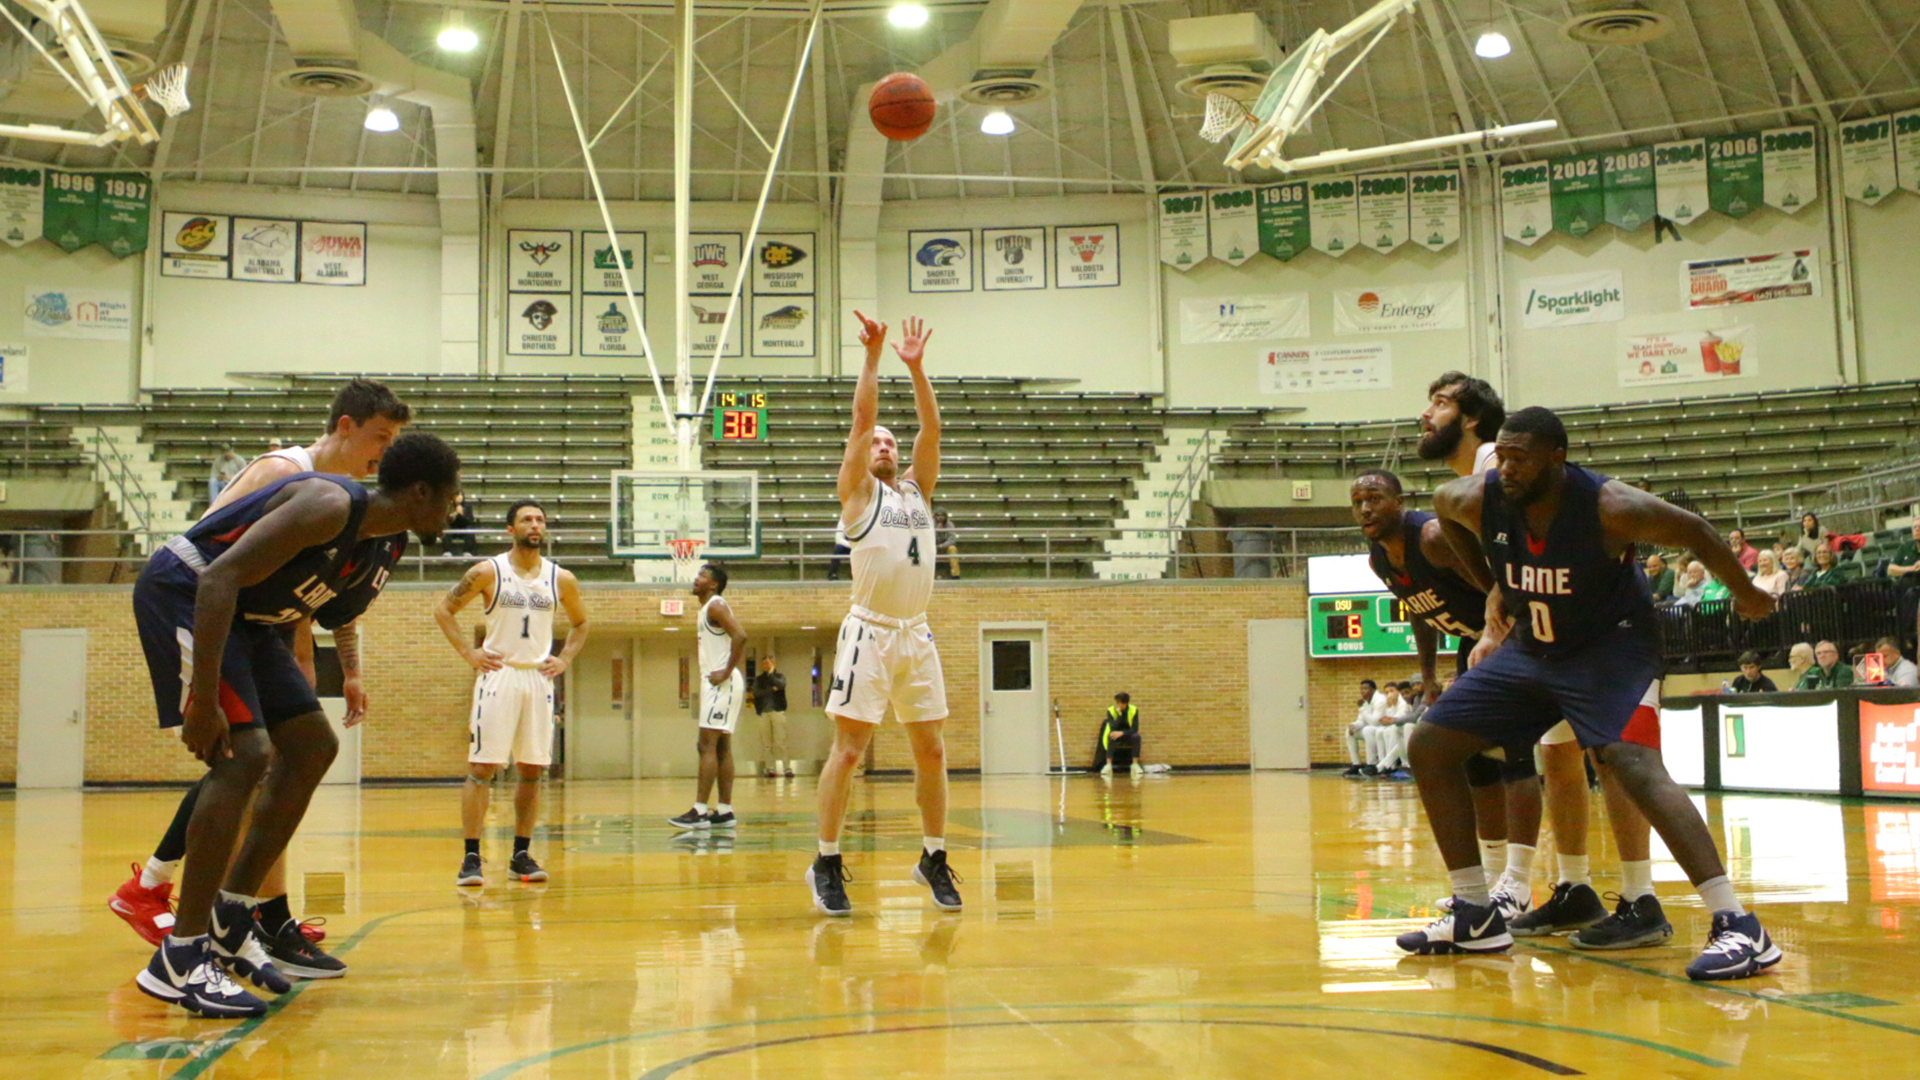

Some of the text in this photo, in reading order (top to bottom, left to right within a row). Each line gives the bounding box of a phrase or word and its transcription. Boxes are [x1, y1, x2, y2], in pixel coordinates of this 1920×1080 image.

[1710, 137, 1758, 159] 2006
[1605, 151, 1651, 173] 2003
[1553, 159, 1599, 180] 2002
[51, 173, 95, 192] 1996
[105, 179, 147, 199] 1997
[1261, 185, 1303, 204] 1998
[995, 235, 1032, 251] UNION
[694, 243, 727, 261] UWG
[248, 259, 281, 268] ALABAMA
[1071, 264, 1105, 273] VALDOSTA
[243, 266, 284, 276] HUNTSVILLE
[316, 269, 349, 278] ALABAMA
[526, 271, 553, 279] AUBURN
[763, 272, 804, 280] MISSISSIPPI
[926, 269, 956, 277] SHORTER
[1004, 267, 1024, 275] UNION
[518, 278, 562, 287] MONTGOMERY
[922, 277, 960, 286] UNIVERSITY
[995, 275, 1034, 284] UNIVERSITY
[1078, 273, 1098, 281] STATE
[604, 280, 623, 288] STATE
[697, 281, 724, 289] GEORGIA
[1691, 280, 1727, 294] GUARD
[1538, 288, 1621, 312] Sparklight
[1381, 303, 1435, 319] Entergy
[1555, 306, 1590, 315] Business
[522, 334, 557, 342] CHRISTIAN
[522, 342, 556, 350] BROTHERS
[599, 343, 626, 351] FLORIDA
[692, 343, 729, 351] UNIVERSTY
[1642, 350, 1665, 358] DARE
[721, 393, 735, 407] 14
[751, 393, 765, 408] 15
[723, 411, 758, 439] 30
[1295, 487, 1309, 497] EXIT
[880, 506, 911, 529] Delta
[908, 536, 920, 566] 4
[1505, 563, 1573, 595] LANE
[293, 574, 338, 609] LAN
[499, 590, 553, 611] Delta State
[1335, 600, 1352, 611] DSU
[1401, 588, 1446, 614] LANE
[664, 602, 682, 613] EXIT
[521, 614, 530, 639] 1
[1347, 614, 1362, 638] 6
[1528, 601, 1555, 643] 0
[1337, 642, 1364, 651] BONUS
